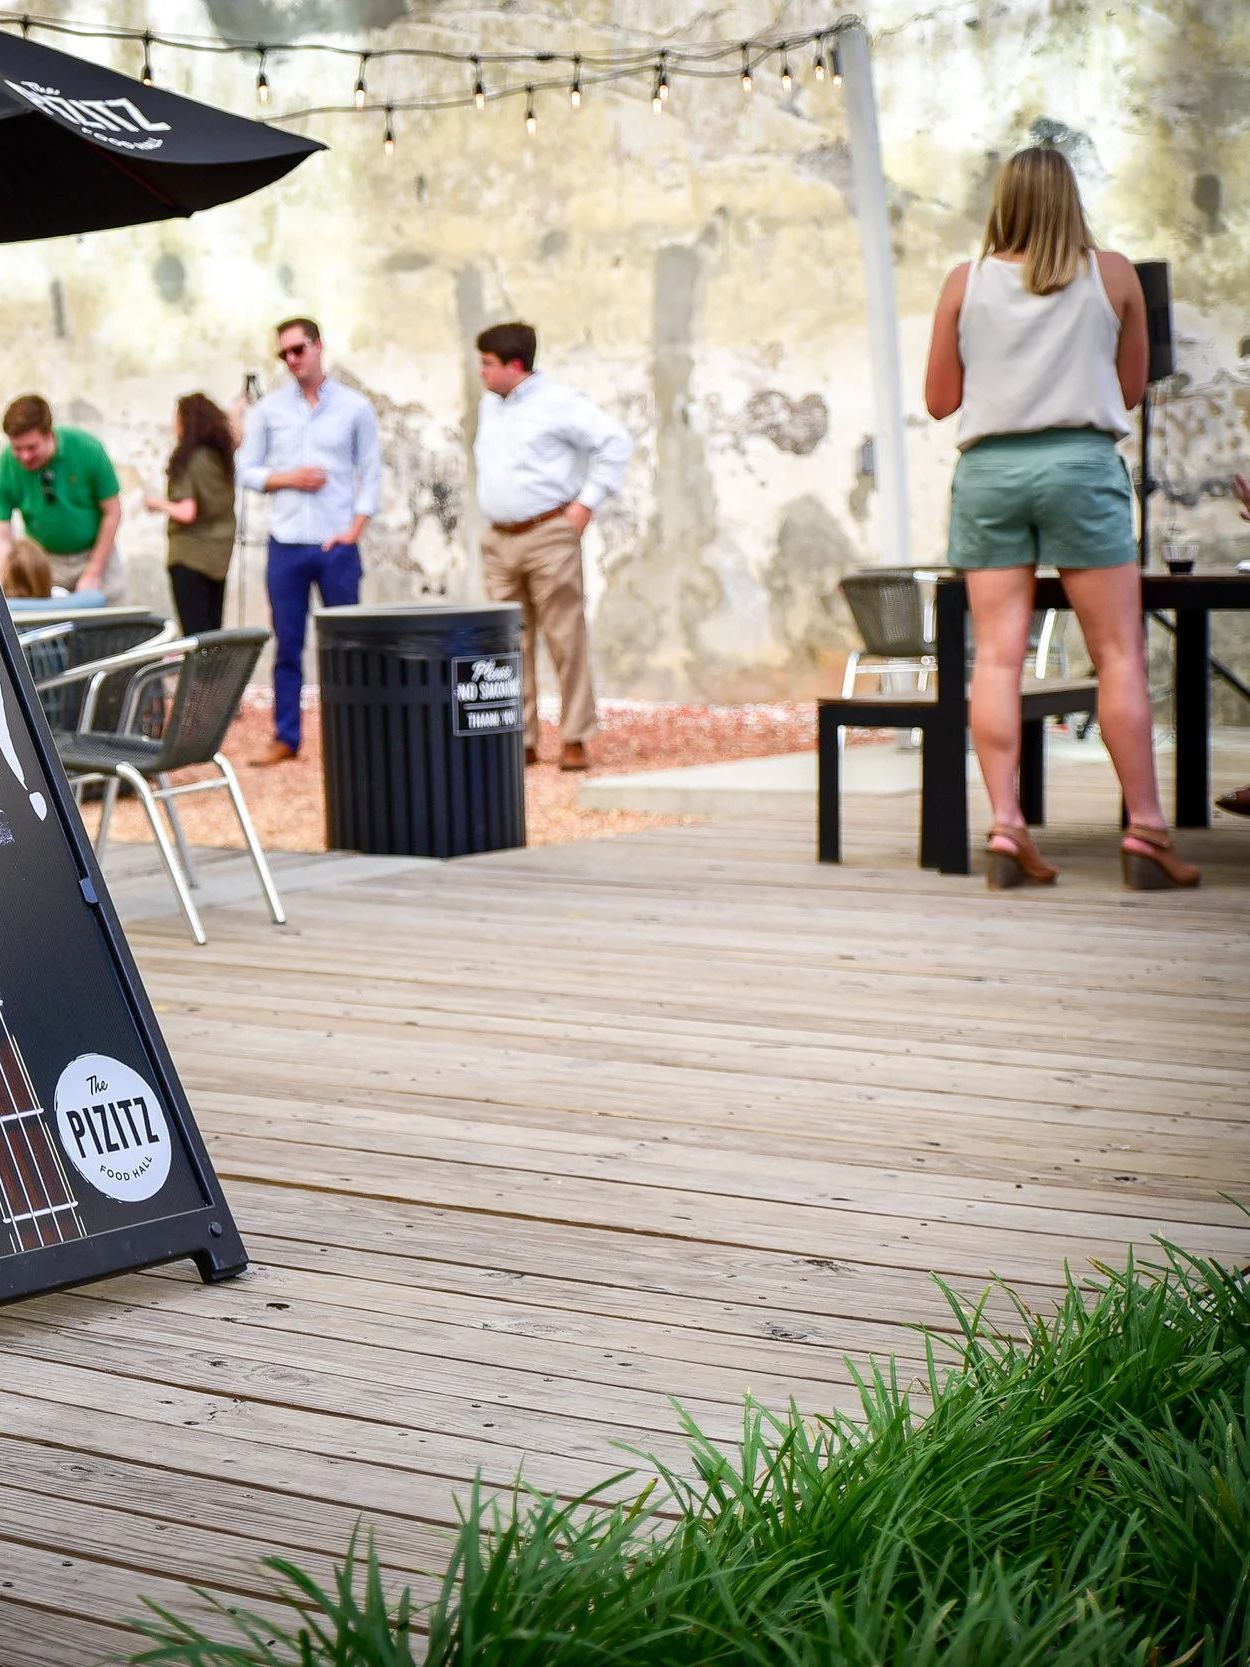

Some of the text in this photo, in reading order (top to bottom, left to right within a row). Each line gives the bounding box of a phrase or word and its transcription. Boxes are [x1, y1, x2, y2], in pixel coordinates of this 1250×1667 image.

[85, 1074, 109, 1096] The
[65, 1096, 161, 1159] PIZITZ
[100, 1156, 153, 1181] FOOD HALL
